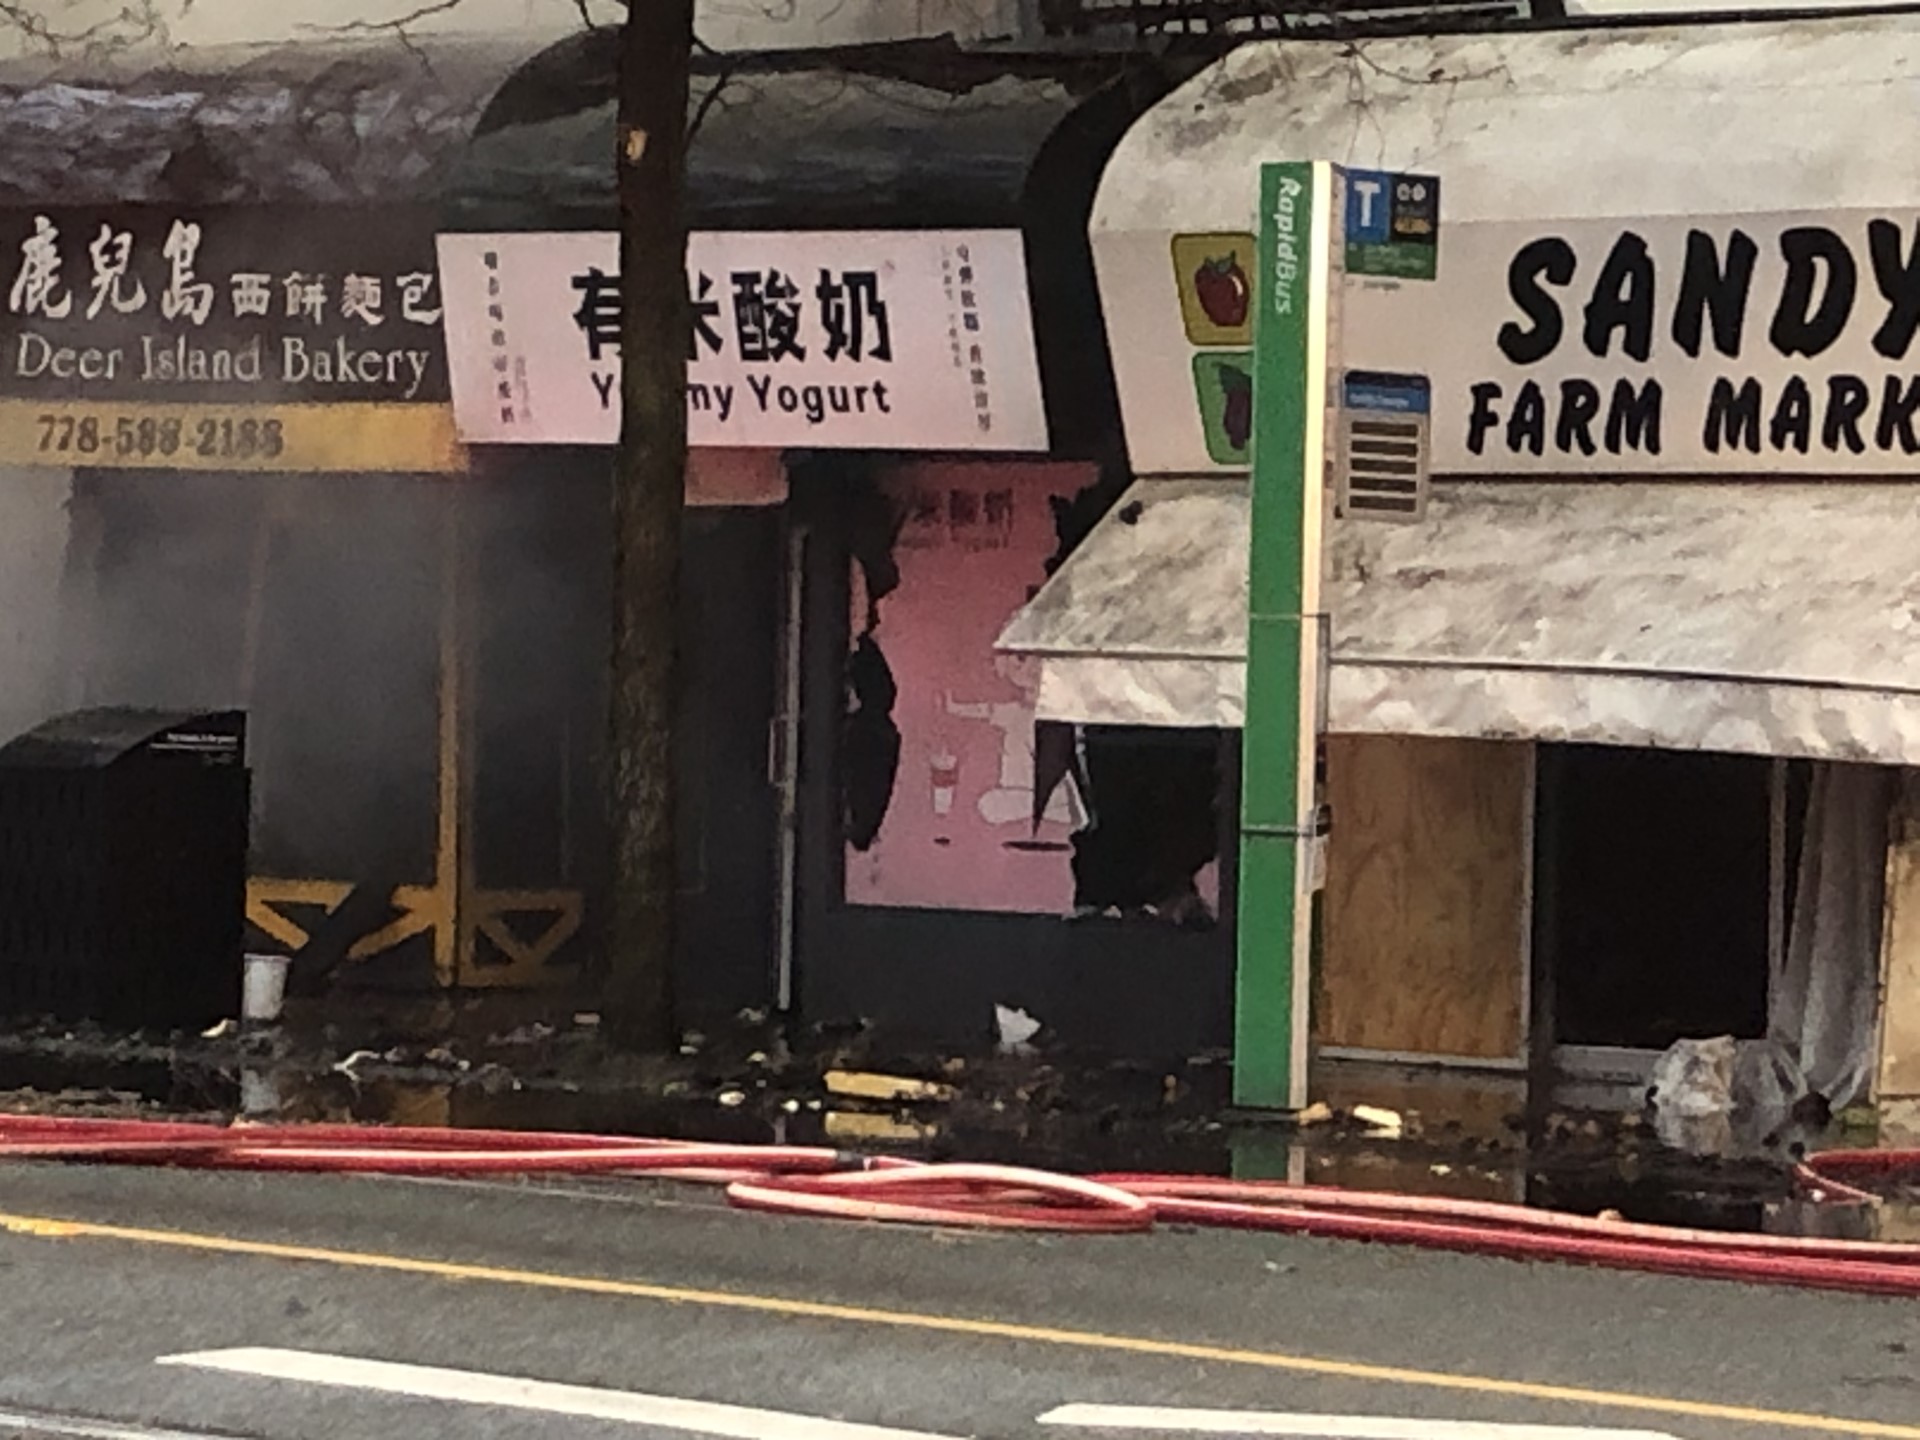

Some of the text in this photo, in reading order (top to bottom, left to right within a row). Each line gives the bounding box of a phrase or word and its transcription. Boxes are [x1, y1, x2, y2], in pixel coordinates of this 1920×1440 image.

[10, 214, 216, 325] 鹿兒島
[1273, 176, 1302, 315] RapidBus
[16, 330, 429, 398] Deer Island Bakery
[590, 371, 734, 422] Ymy
[746, 373, 892, 424] Yogurt
[1466, 378, 1662, 457] FARM
